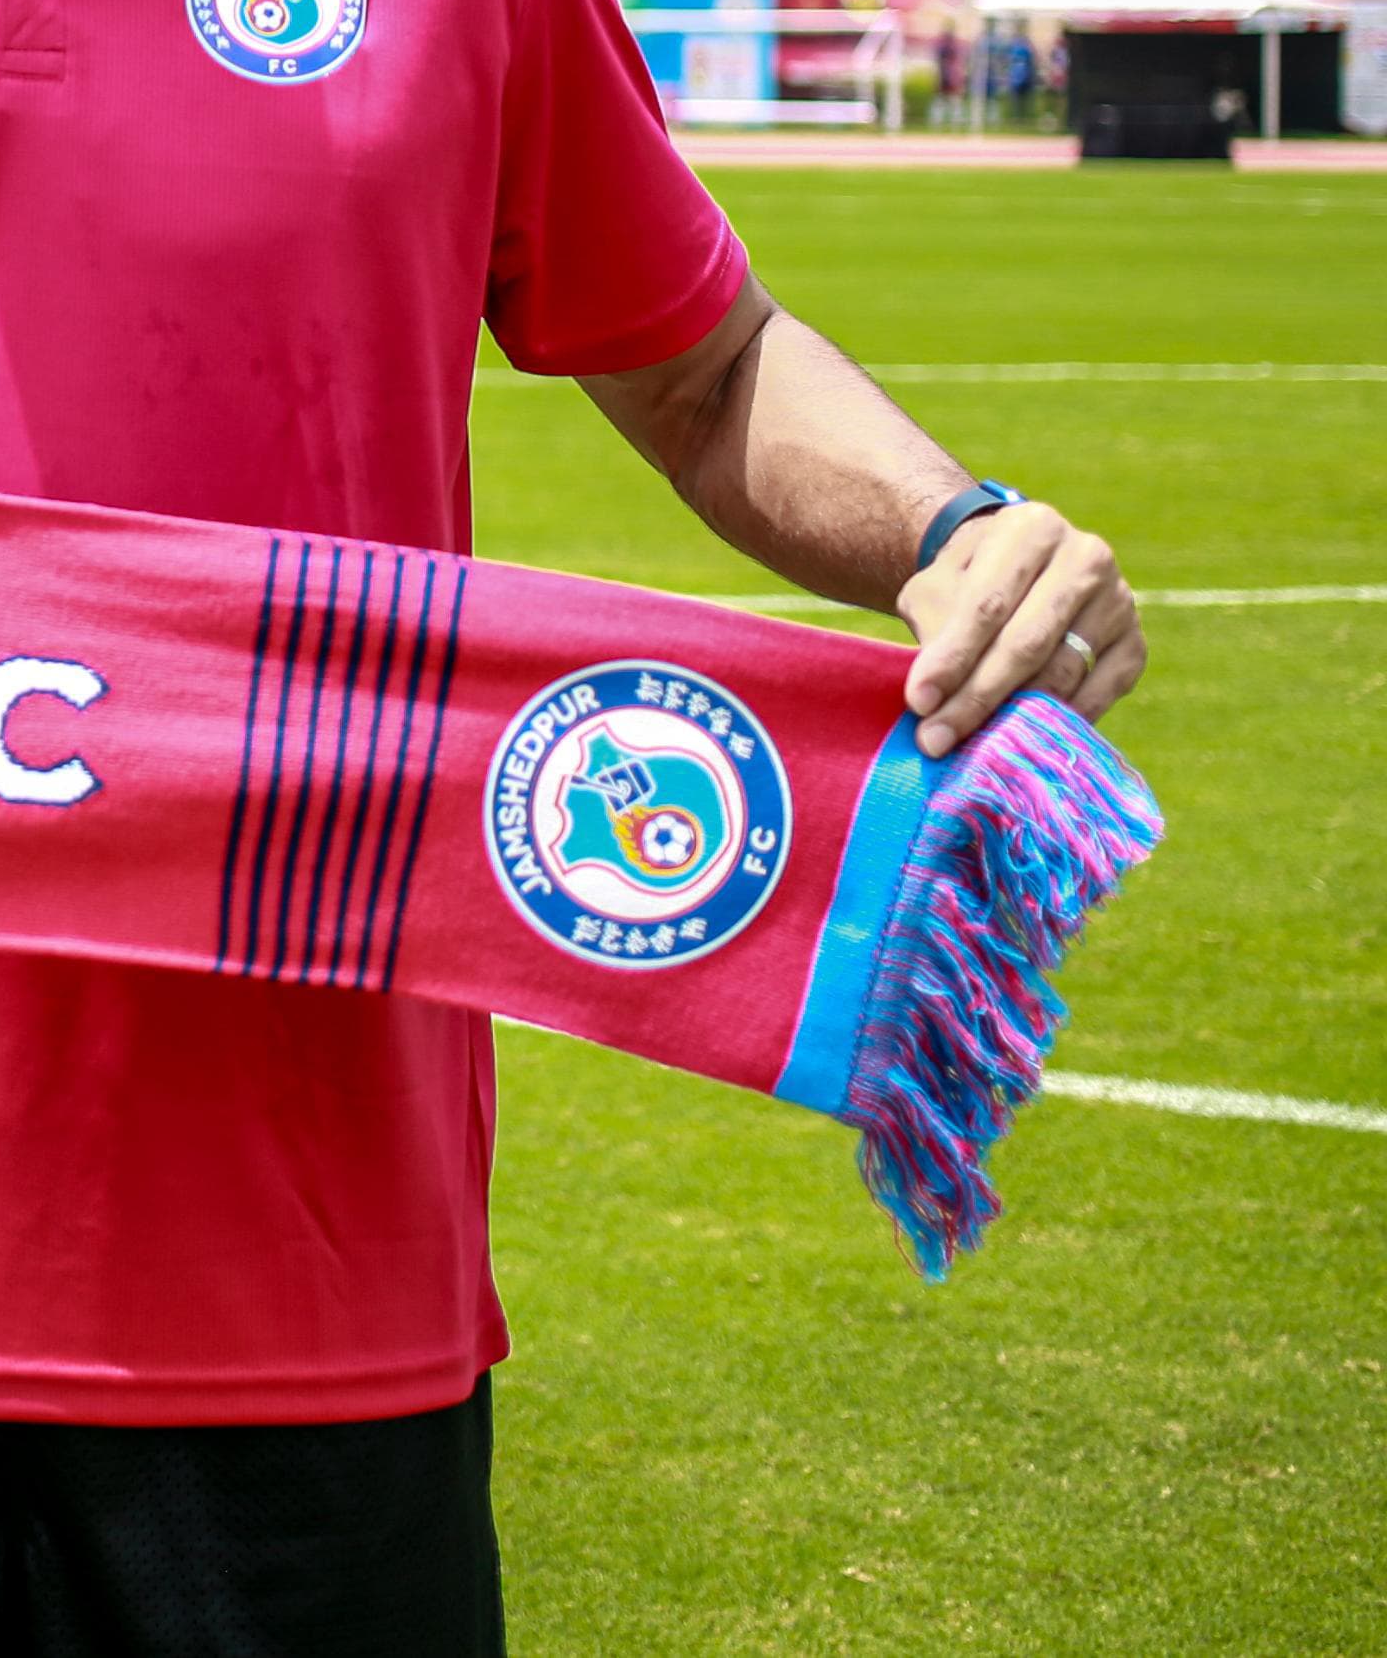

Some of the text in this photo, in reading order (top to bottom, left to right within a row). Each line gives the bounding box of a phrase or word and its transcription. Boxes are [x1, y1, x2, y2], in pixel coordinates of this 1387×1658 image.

[268, 58, 298, 74] FC
[497, 683, 601, 896] JAMSHEDPUR
[743, 826, 777, 876] FC
